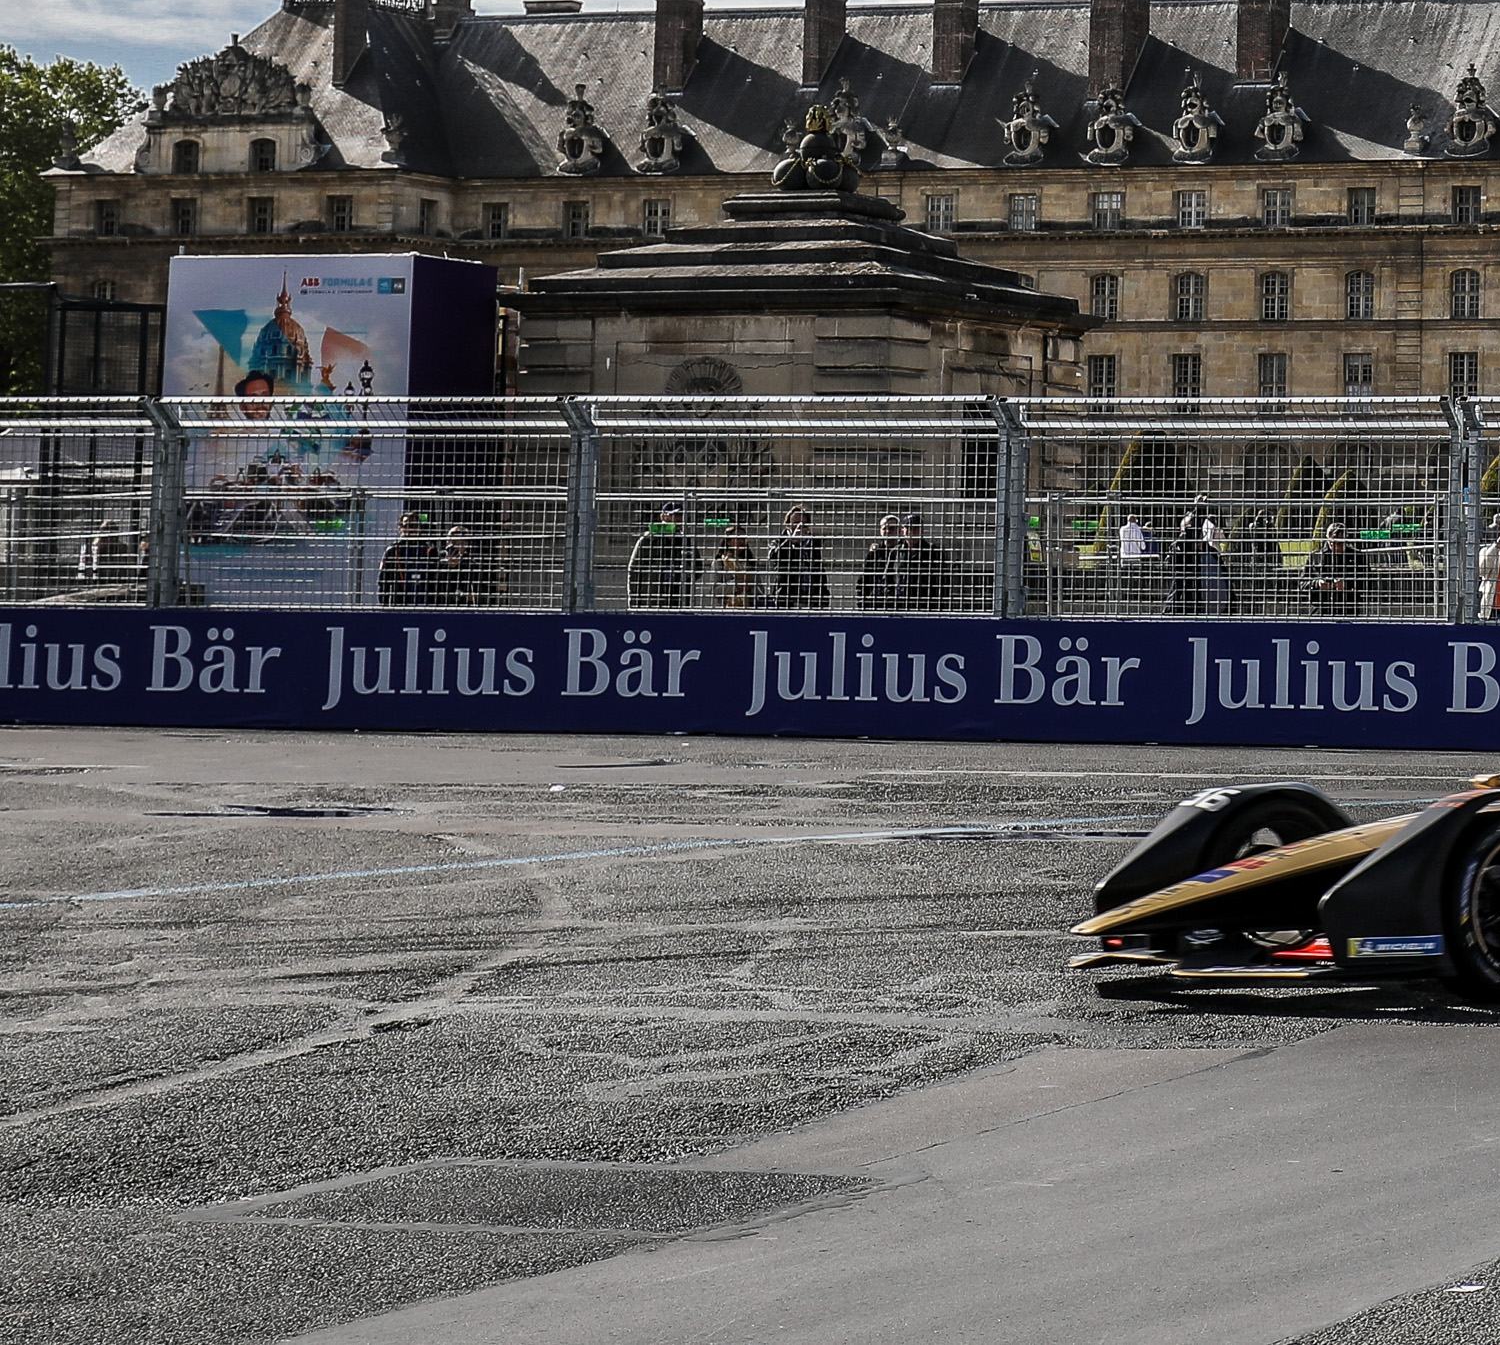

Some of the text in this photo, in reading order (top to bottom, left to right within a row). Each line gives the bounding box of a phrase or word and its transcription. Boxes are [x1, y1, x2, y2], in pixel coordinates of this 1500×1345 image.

[301, 277, 320, 287] ABB
[146, 625, 281, 693] Bär
[322, 627, 701, 710] Julius Bär
[746, 631, 1140, 716] Julius Bär
[1186, 637, 1418, 725] Julius
[1178, 787, 1242, 812] 36
